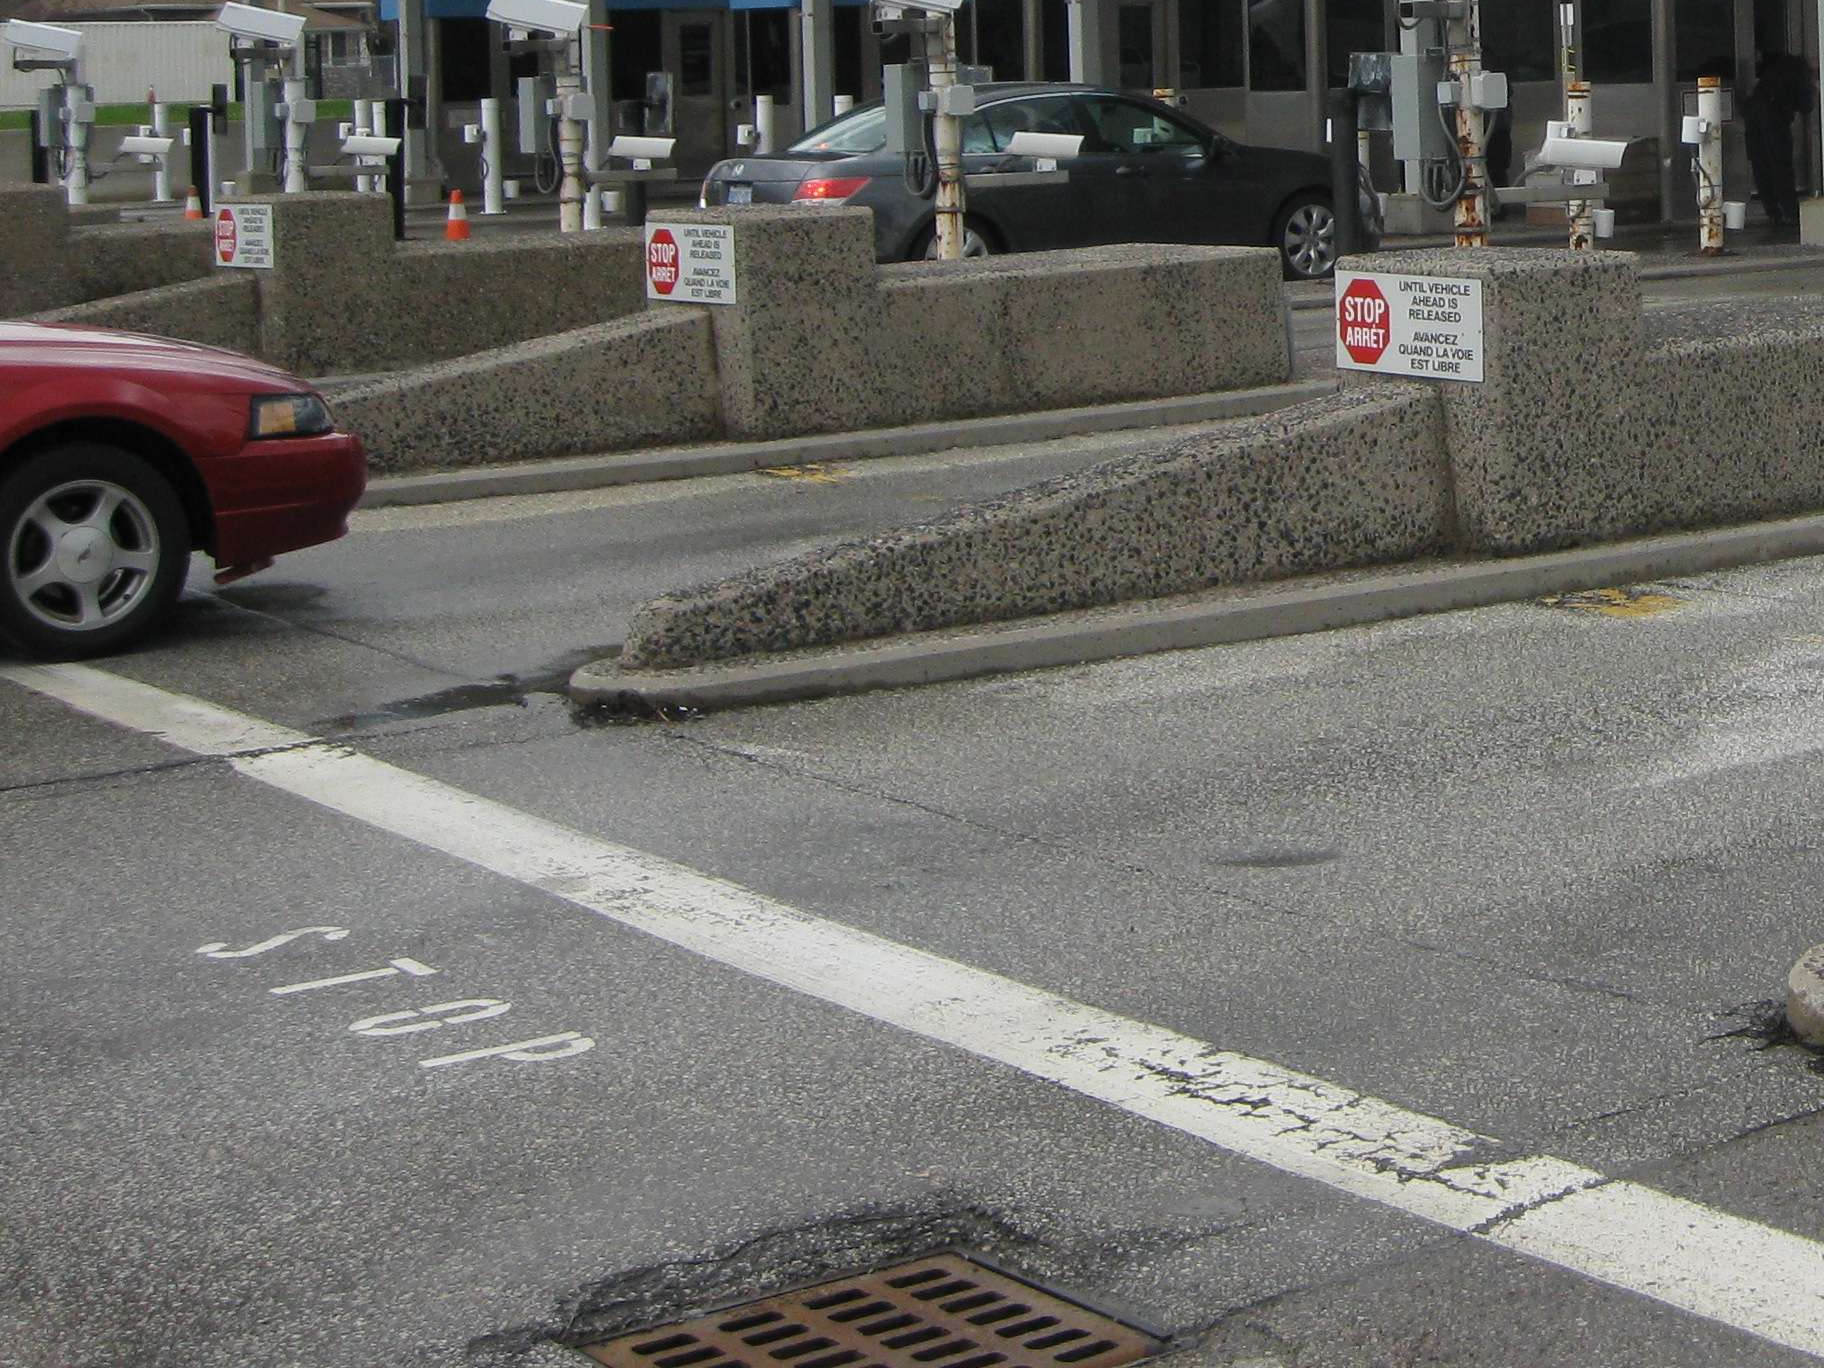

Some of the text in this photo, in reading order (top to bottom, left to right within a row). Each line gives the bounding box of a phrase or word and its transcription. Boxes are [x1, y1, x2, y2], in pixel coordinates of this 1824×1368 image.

[651, 243, 676, 263] STOP
[1399, 281, 1471, 296] UNTIL VEHICLE
[1345, 296, 1385, 323] STOP
[1411, 296, 1458, 309] AHEAD IS
[1408, 309, 1462, 323] RELEASED
[1413, 332, 1458, 345] AVANCEZ
[1398, 344, 1474, 361] QUAND LA VOIE
[1411, 359, 1461, 374] EST LIBRE
[195, 925, 596, 1068] STOP
